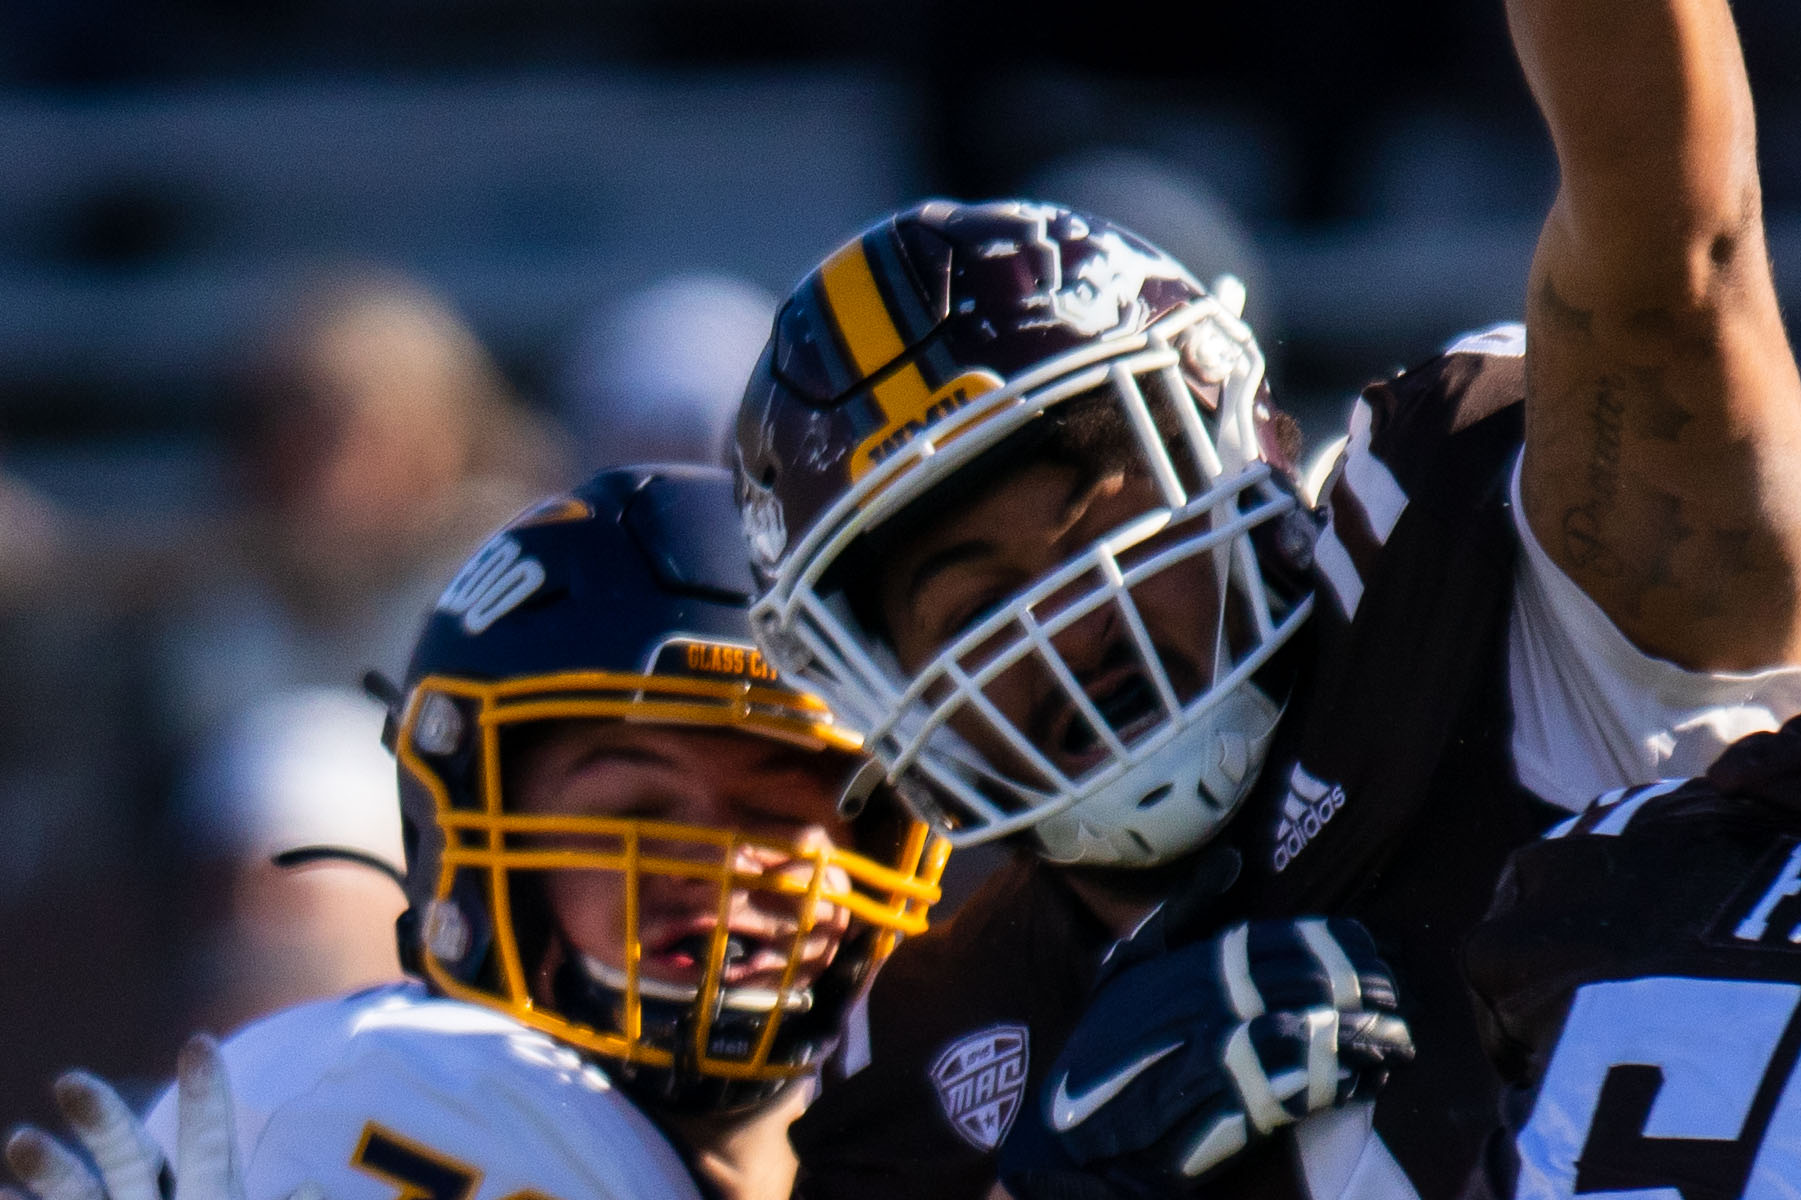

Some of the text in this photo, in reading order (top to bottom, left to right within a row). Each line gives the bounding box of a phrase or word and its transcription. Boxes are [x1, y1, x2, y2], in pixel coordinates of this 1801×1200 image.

[687, 643, 745, 674] GLASS
[1274, 784, 1346, 872] adidas
[948, 1055, 1026, 1118] MAC
